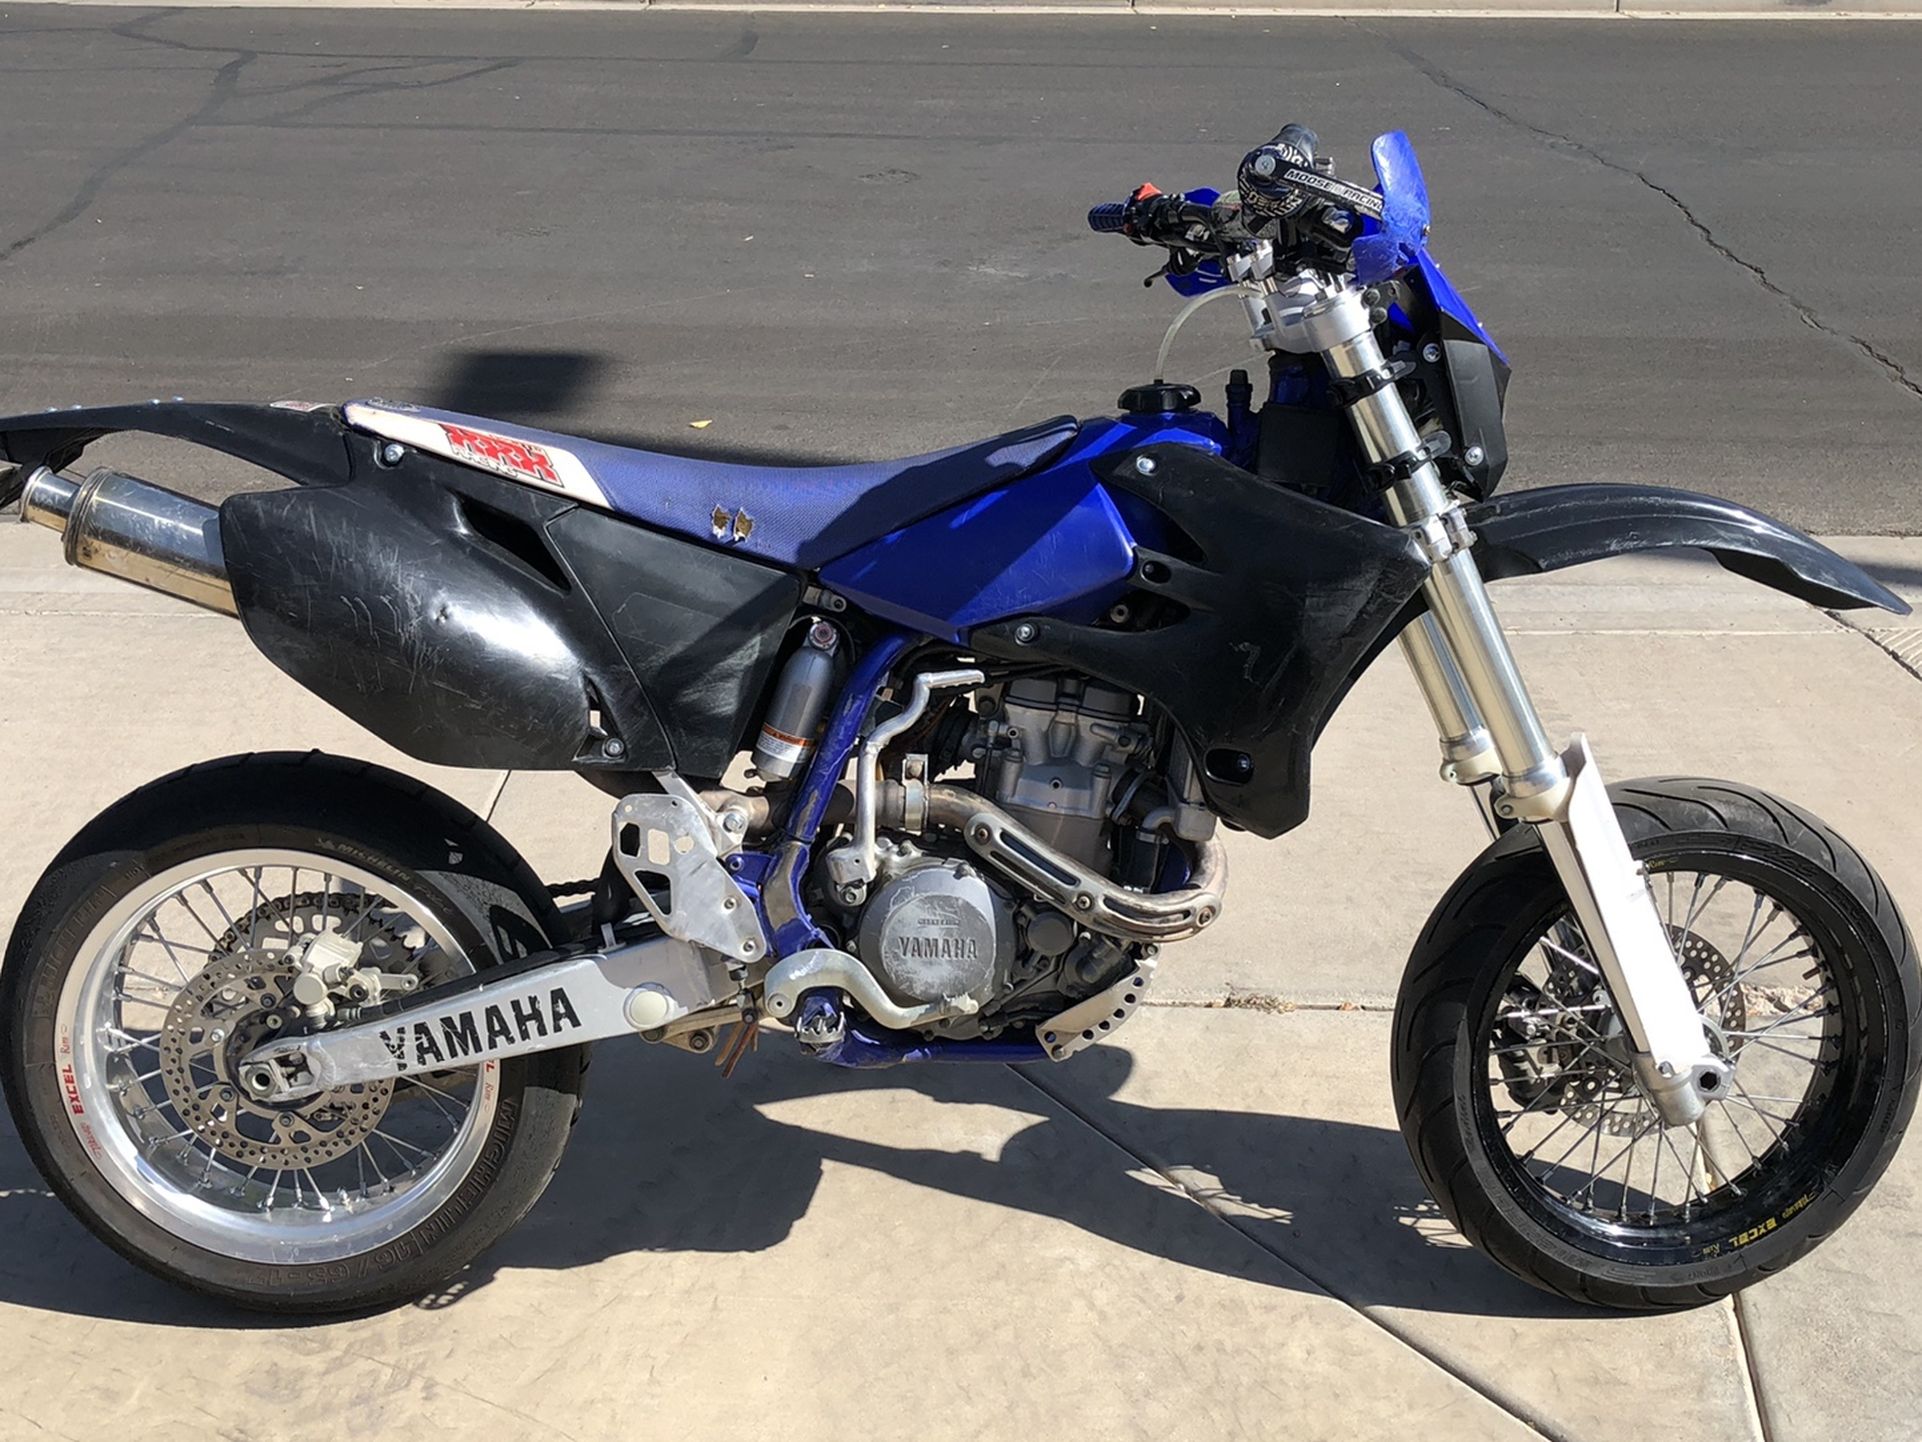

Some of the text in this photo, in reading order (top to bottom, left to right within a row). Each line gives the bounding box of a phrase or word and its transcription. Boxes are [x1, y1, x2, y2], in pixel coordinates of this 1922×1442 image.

[1286, 170, 1333, 190] MOOSE
[898, 936, 978, 960] YAMAHA
[380, 987, 582, 1071] YAMAHA
[62, 1064, 85, 1115] EXCEL
[423, 1100, 518, 1244] MICHELIN
[1728, 1217, 1777, 1247] EXCEL
